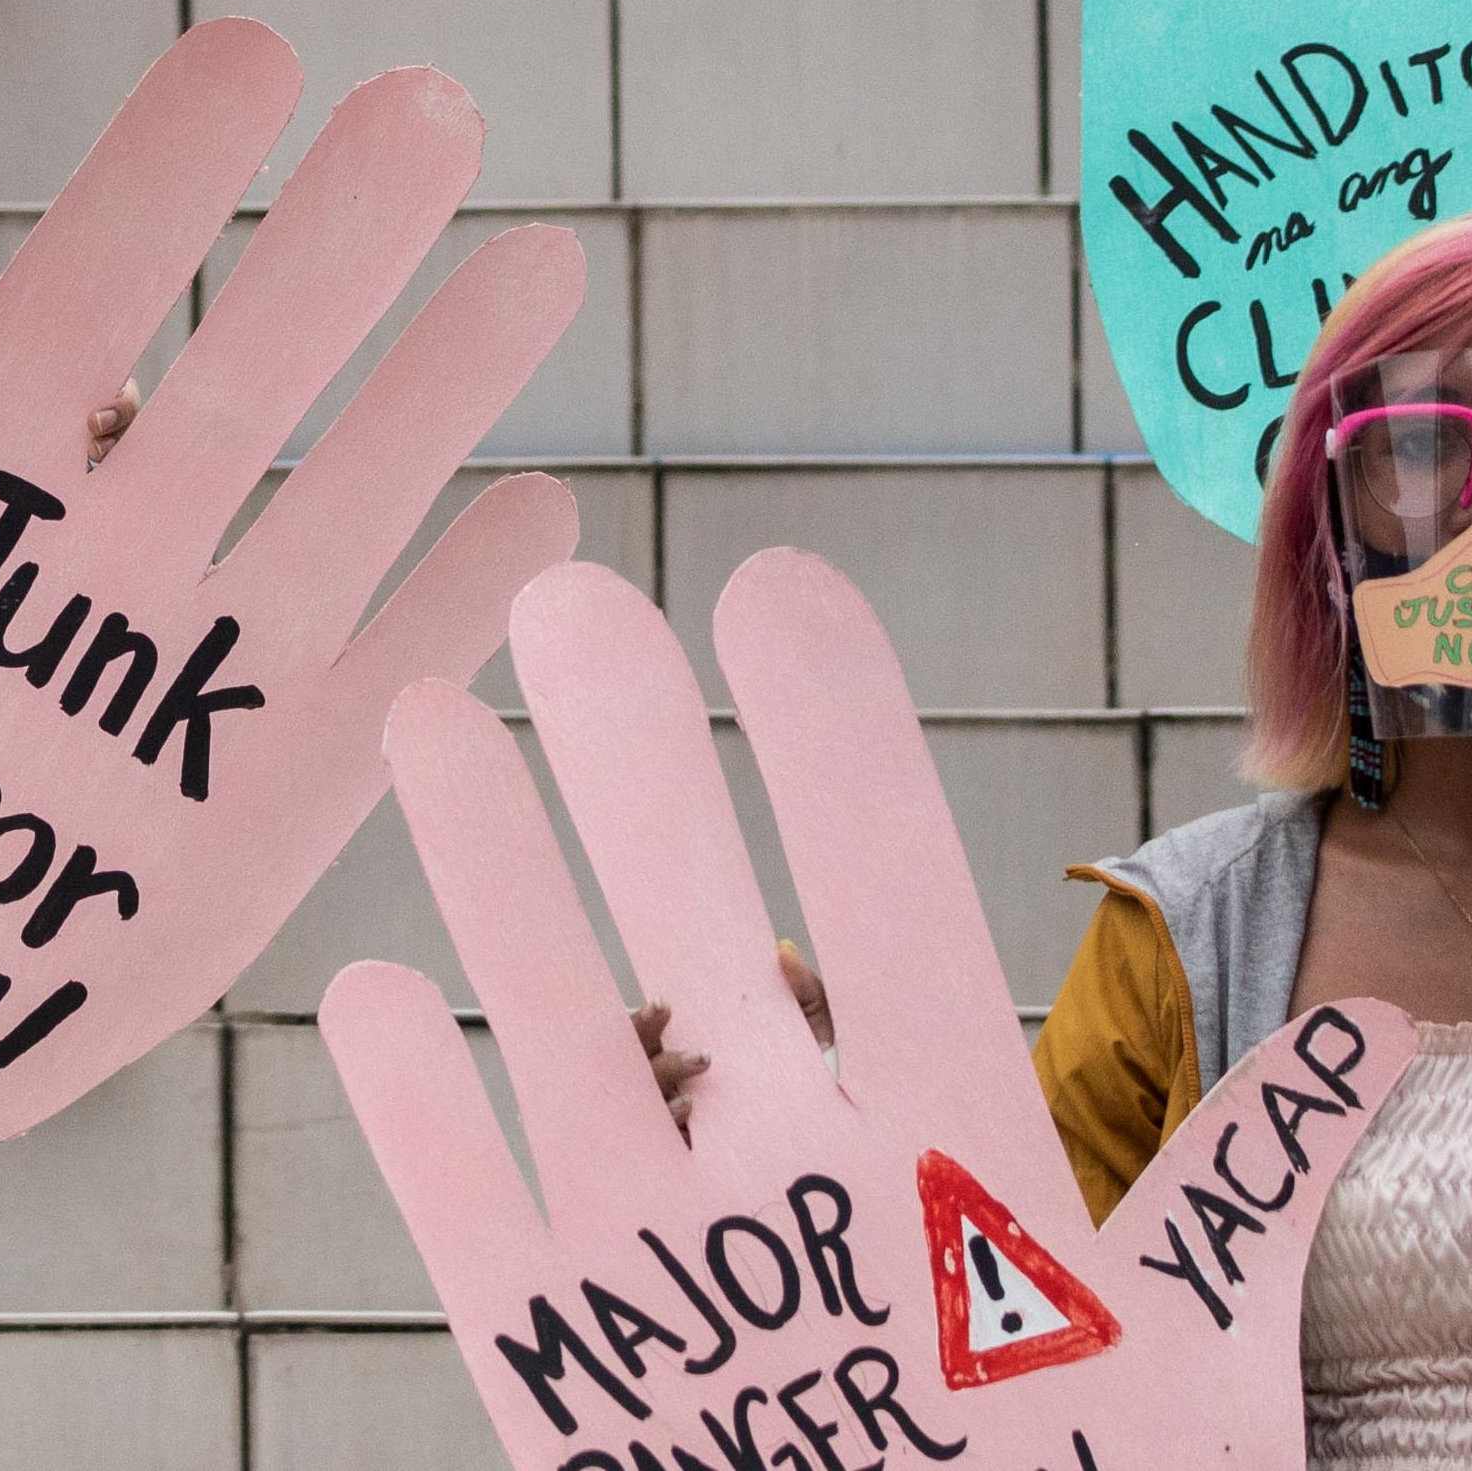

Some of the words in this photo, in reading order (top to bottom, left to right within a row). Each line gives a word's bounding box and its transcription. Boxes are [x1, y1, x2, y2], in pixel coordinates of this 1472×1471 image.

[1338, 148, 1452, 220] ang
[1139, 1004, 1365, 1331] YACAP
[495, 1174, 890, 1434] MAJOR
